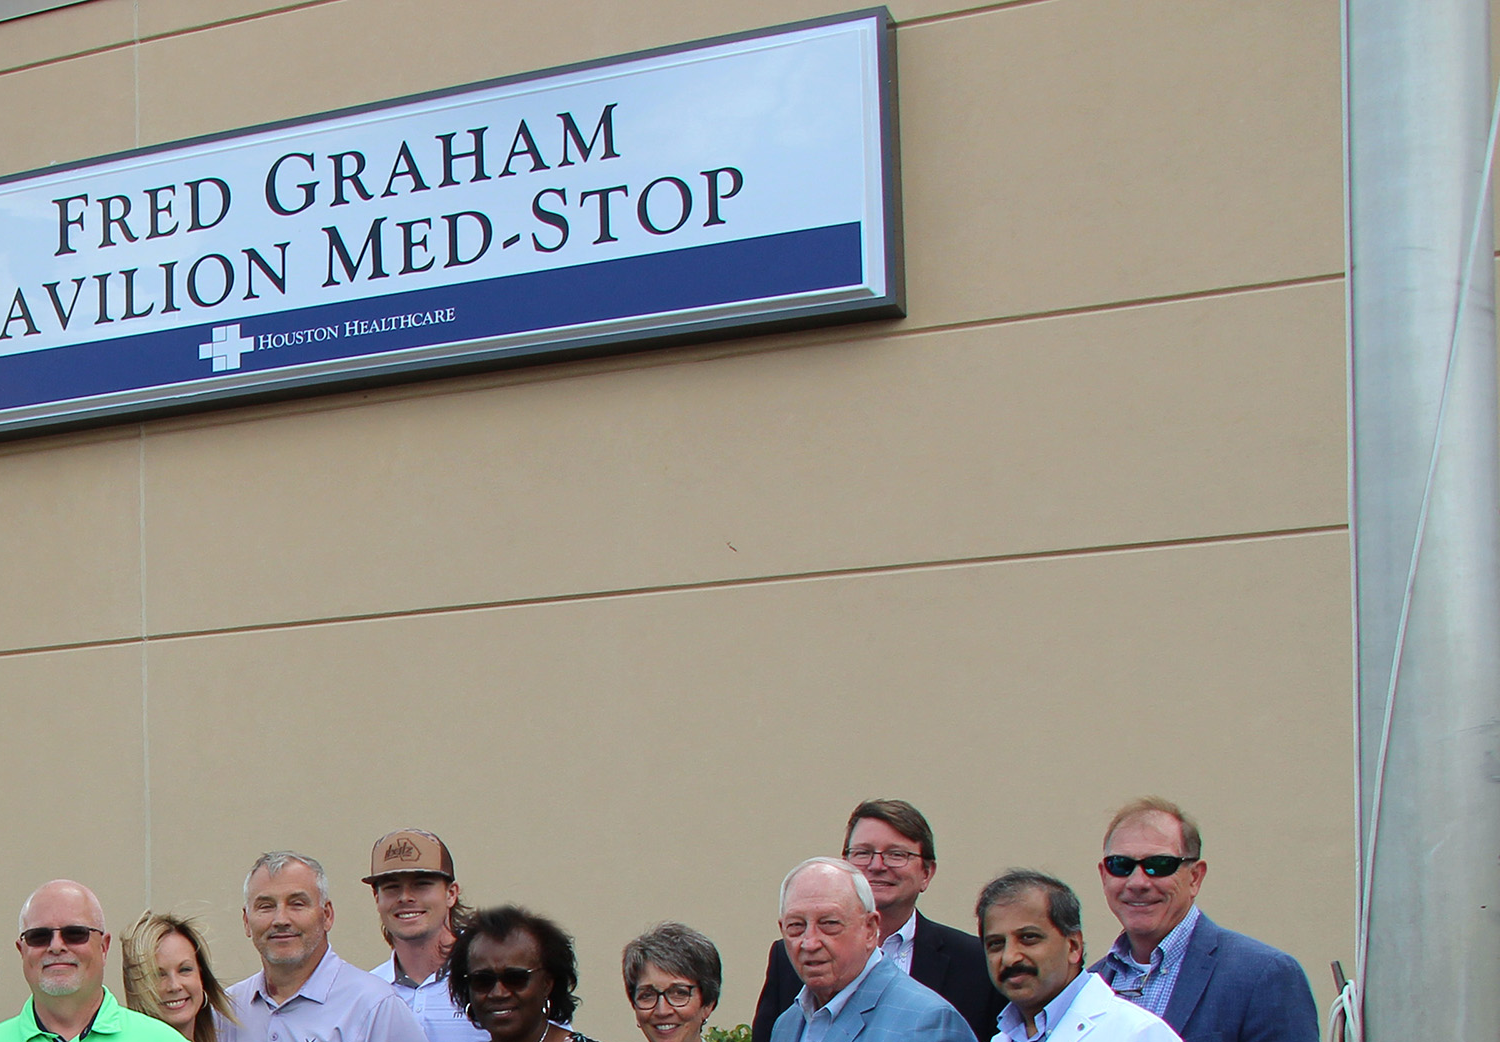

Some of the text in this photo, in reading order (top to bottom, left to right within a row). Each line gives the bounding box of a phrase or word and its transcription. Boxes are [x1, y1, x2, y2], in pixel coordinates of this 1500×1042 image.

[51, 102, 621, 257] FRED GRAHAM
[321, 166, 744, 288] MED-STOP
[258, 307, 456, 351] HOUSTON HEALTHCARE
